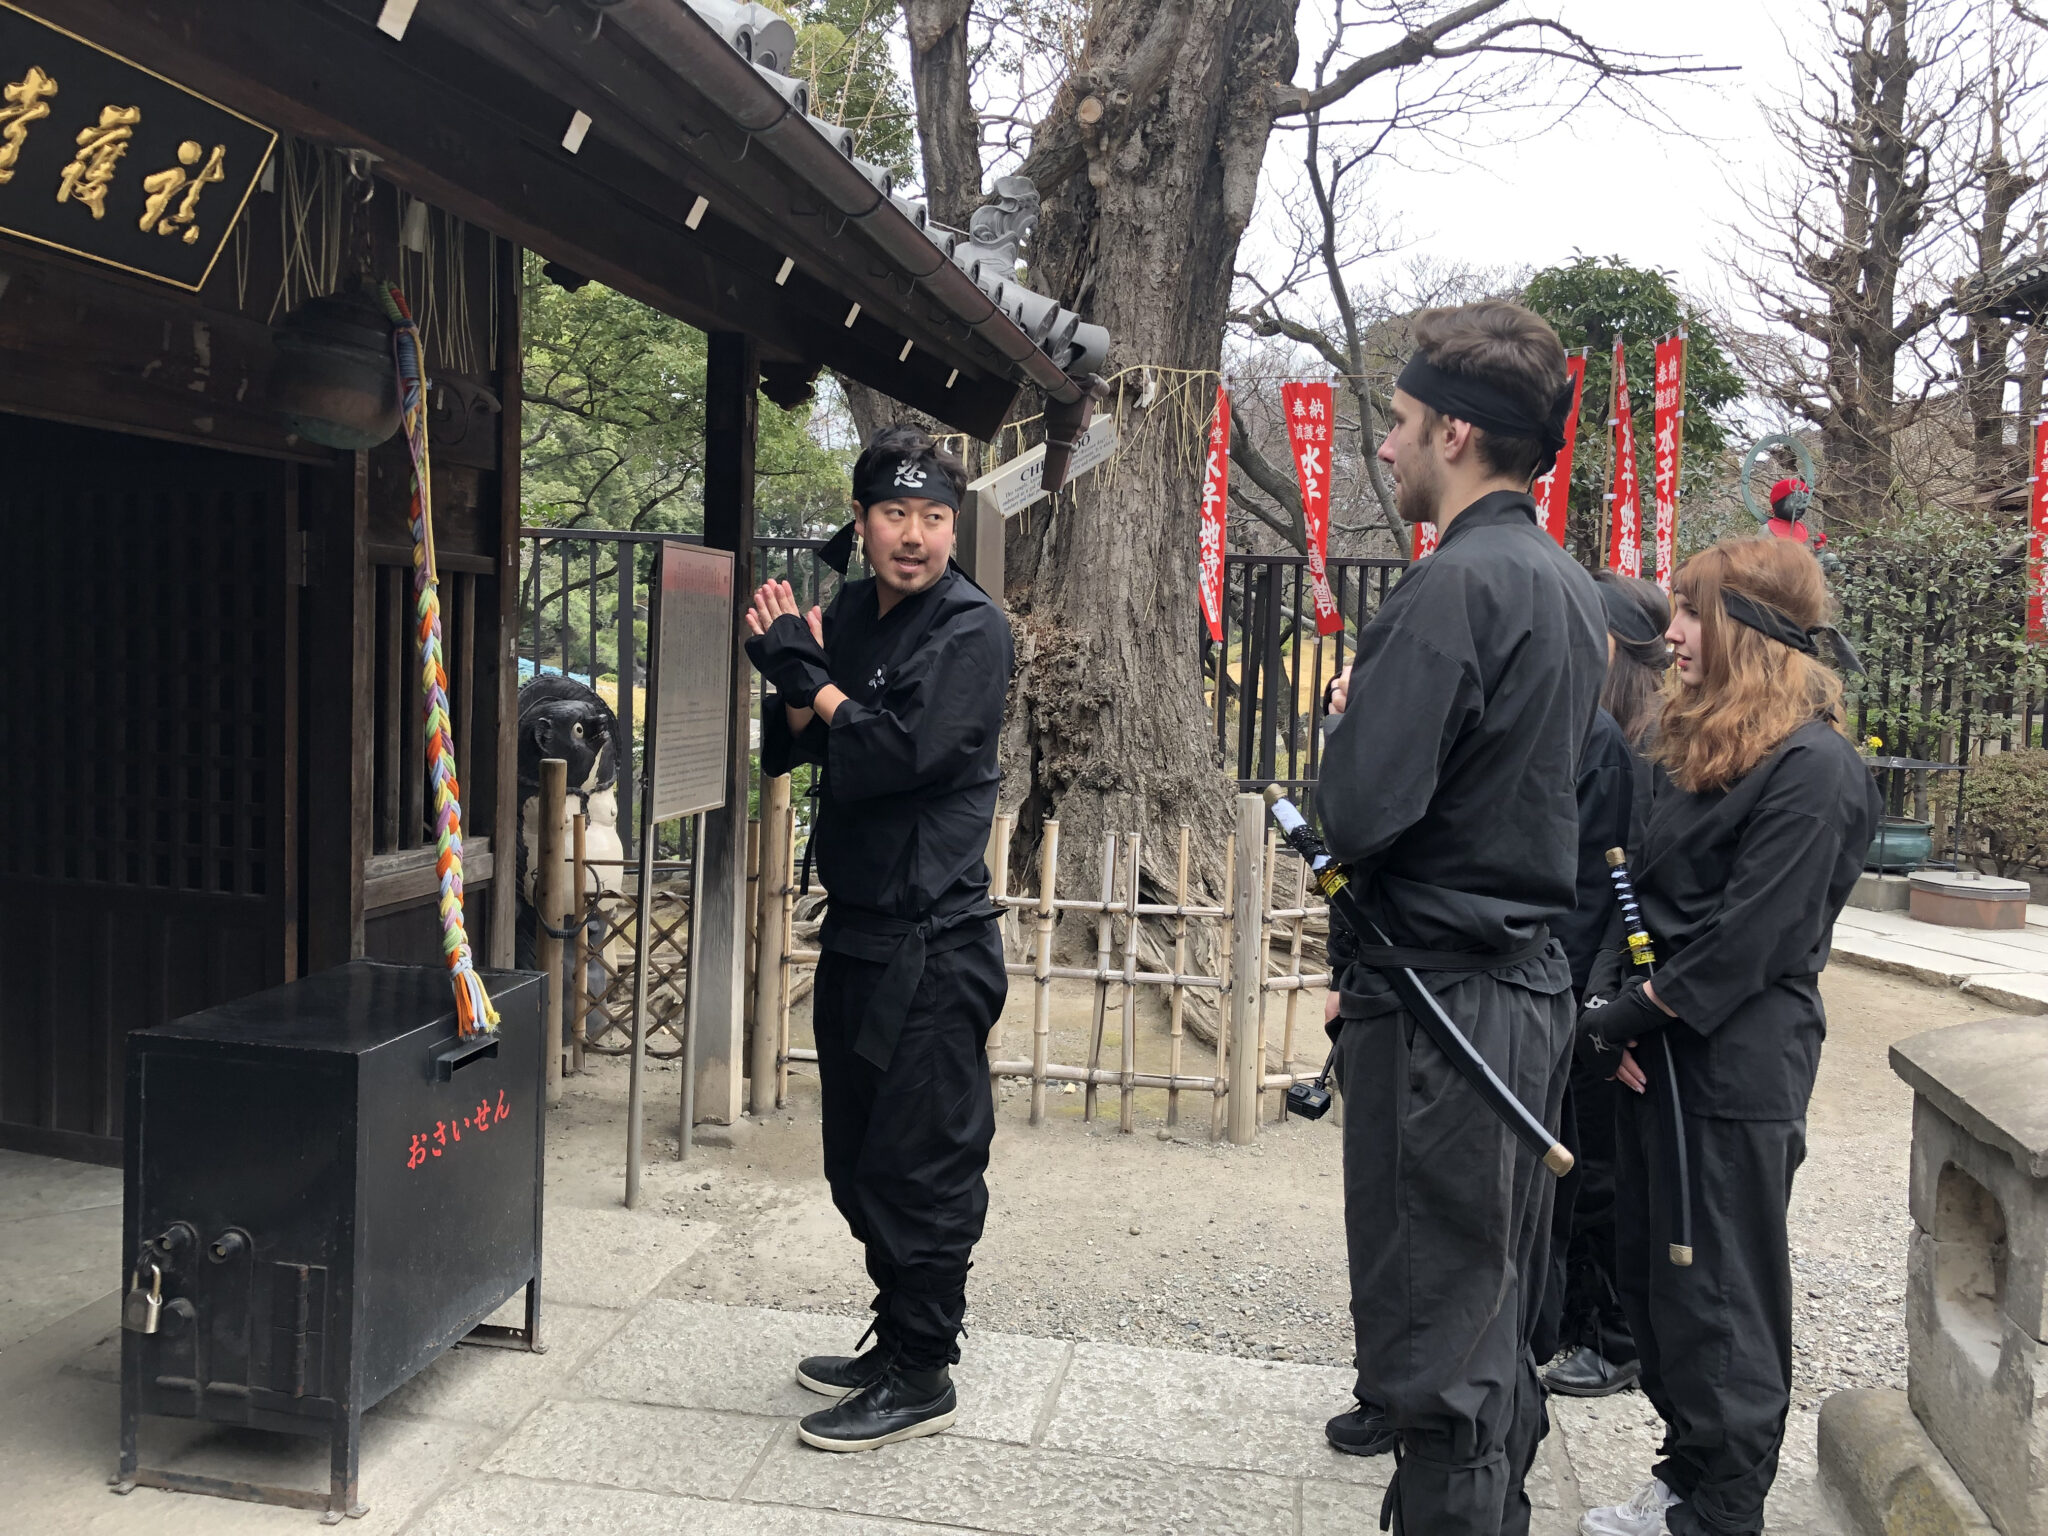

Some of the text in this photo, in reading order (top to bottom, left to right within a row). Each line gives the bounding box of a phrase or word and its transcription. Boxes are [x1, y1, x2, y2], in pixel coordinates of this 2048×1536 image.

[1292, 397, 1325, 421] 奉納
[407, 1089, 511, 1170] おさいせん
